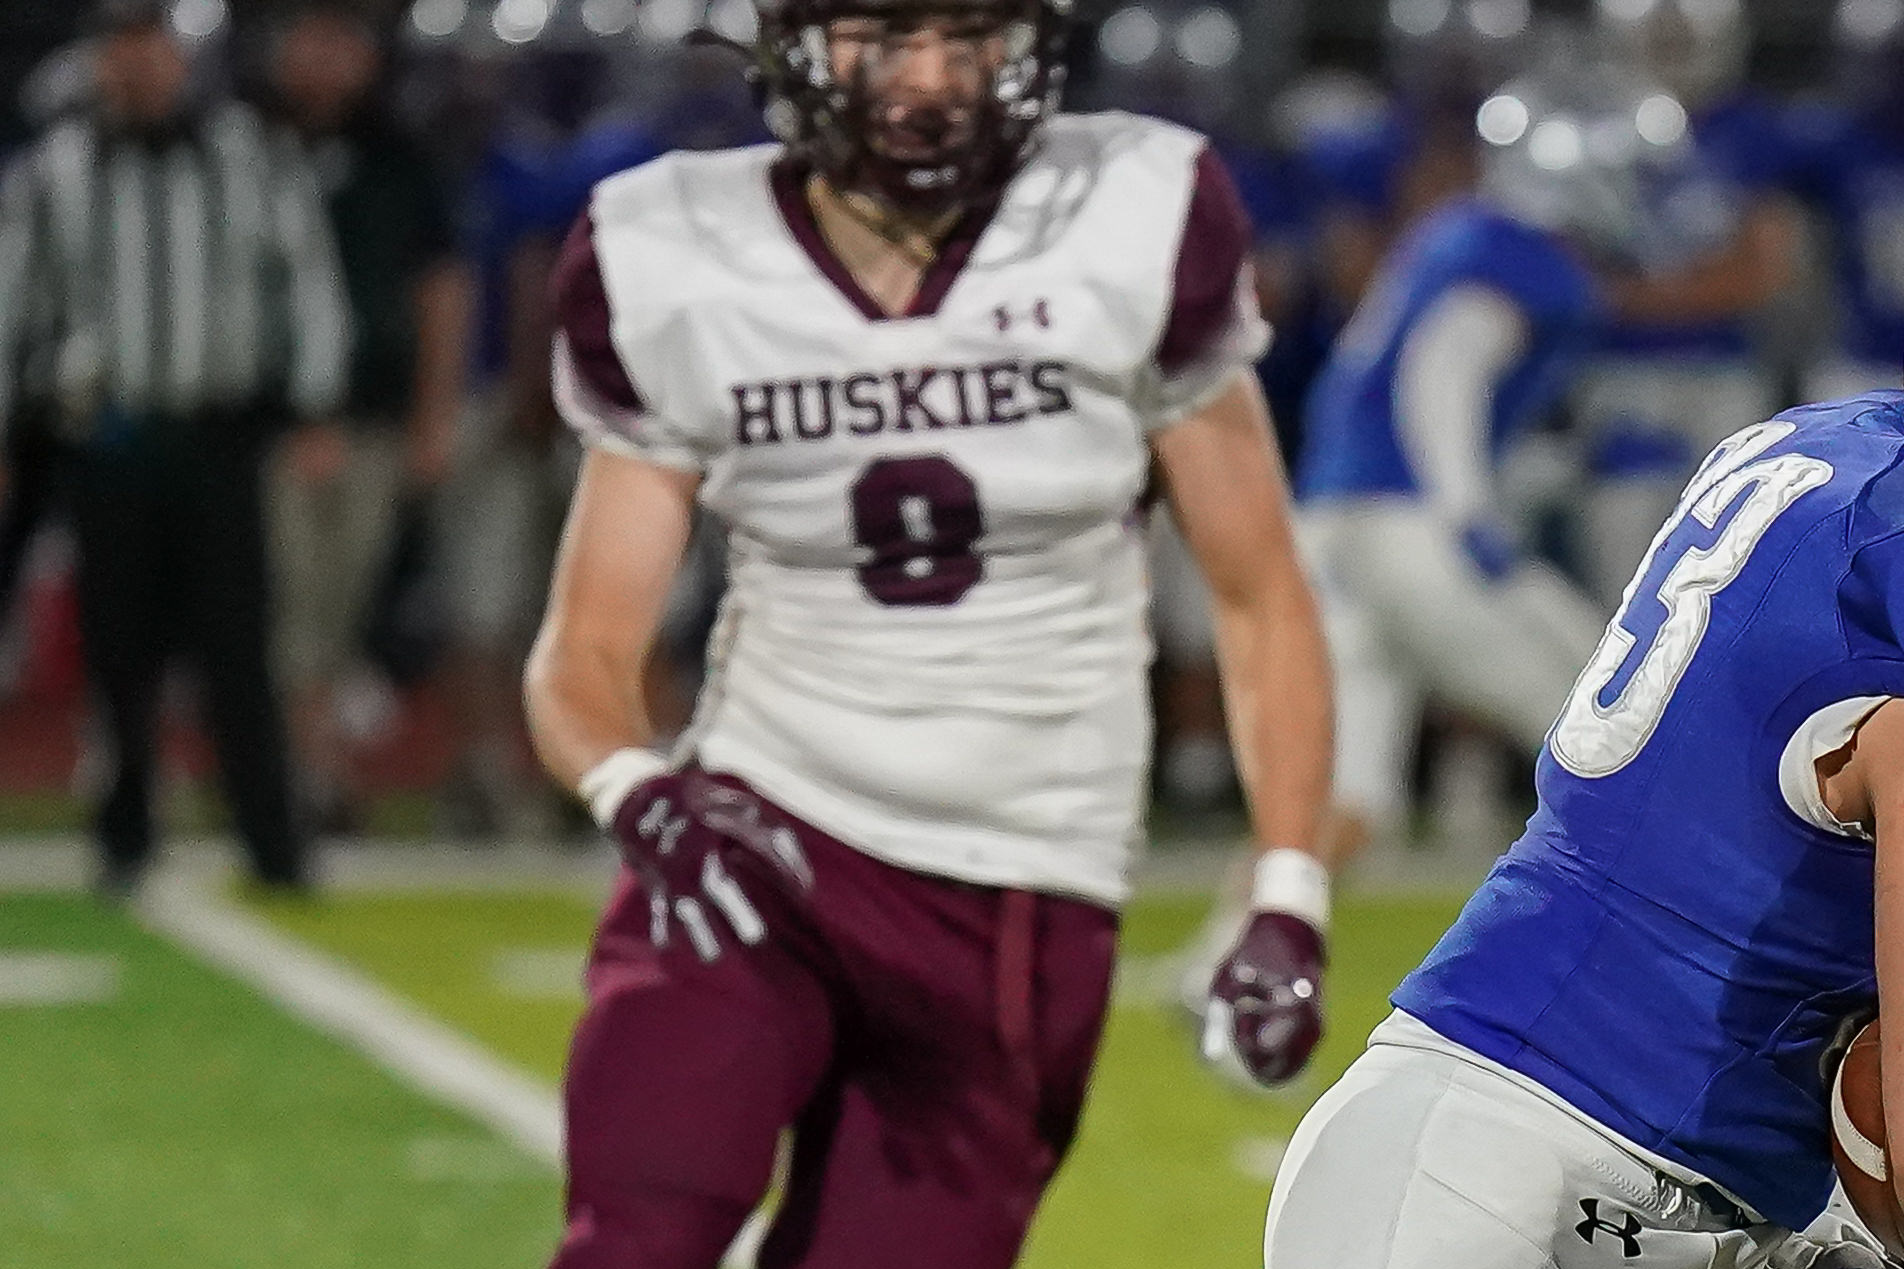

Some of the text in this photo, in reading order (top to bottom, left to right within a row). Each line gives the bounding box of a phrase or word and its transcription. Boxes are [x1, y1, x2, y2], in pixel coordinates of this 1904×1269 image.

[731, 361, 1072, 446] HUSKIES
[849, 455, 984, 608] 8
[1549, 420, 1834, 778] 3
